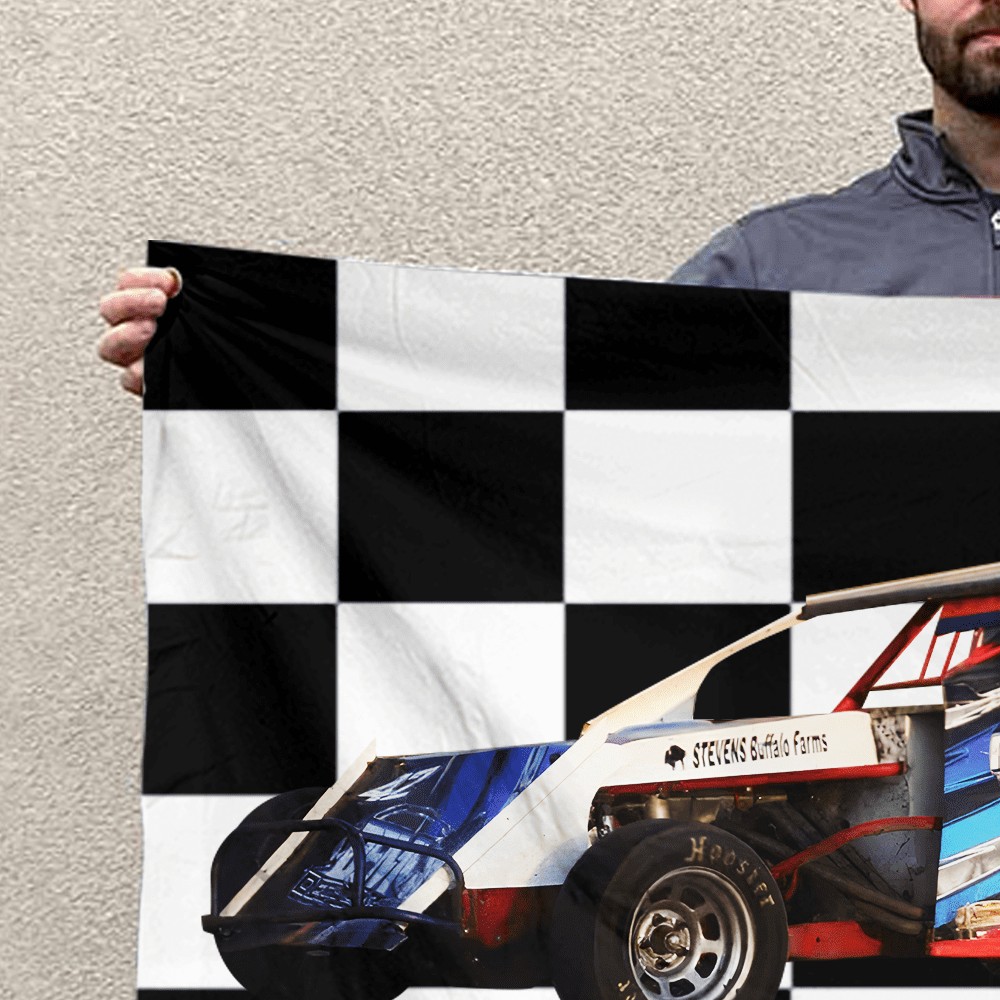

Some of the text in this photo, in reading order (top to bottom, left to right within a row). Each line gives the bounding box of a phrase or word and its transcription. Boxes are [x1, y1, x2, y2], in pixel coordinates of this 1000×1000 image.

[692, 730, 828, 768] STEVENS Buffalo Farms
